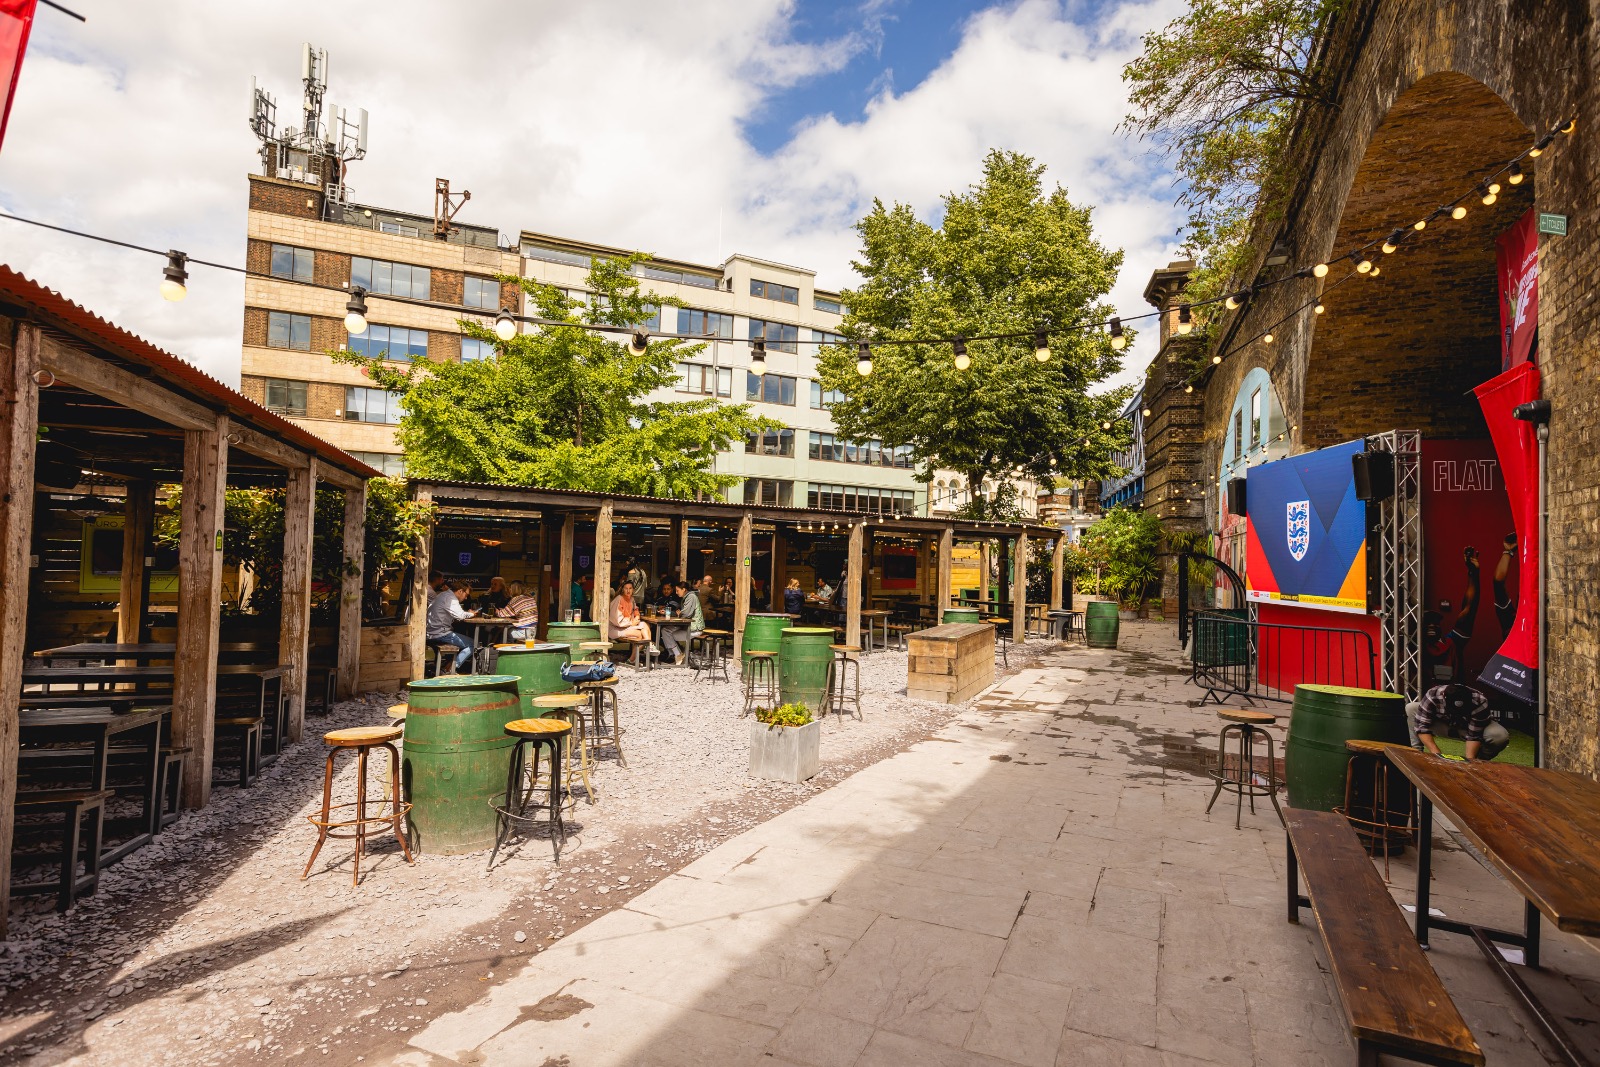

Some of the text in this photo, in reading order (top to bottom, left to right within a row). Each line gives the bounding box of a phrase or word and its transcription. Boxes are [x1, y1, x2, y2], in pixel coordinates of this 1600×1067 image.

[1548, 219, 1565, 231] TOILETS
[1433, 460, 1496, 492] FLAT
[90, 520, 118, 528] URO
